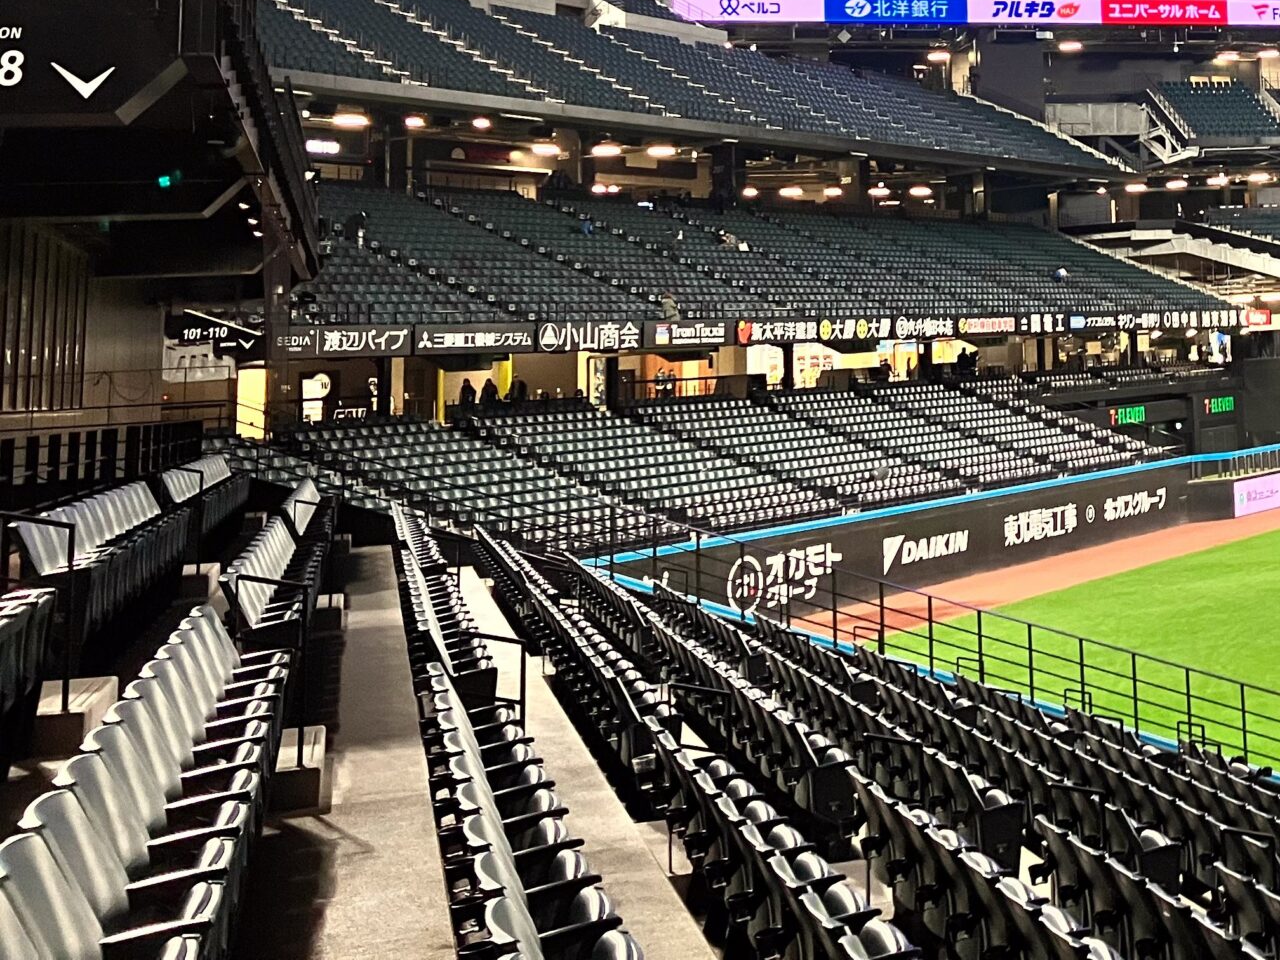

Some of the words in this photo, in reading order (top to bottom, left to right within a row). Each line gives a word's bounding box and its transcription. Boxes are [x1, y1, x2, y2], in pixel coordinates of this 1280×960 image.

[741, 3, 781, 15] ベルコ
[872, 0, 948, 18] 北洋銀行
[992, 1, 1055, 18] アルキタ
[183, 326, 228, 340] 101-110
[558, 321, 640, 351] 小山商会
[901, 530, 969, 565] DAIKIN
[766, 542, 843, 586] オカモト
